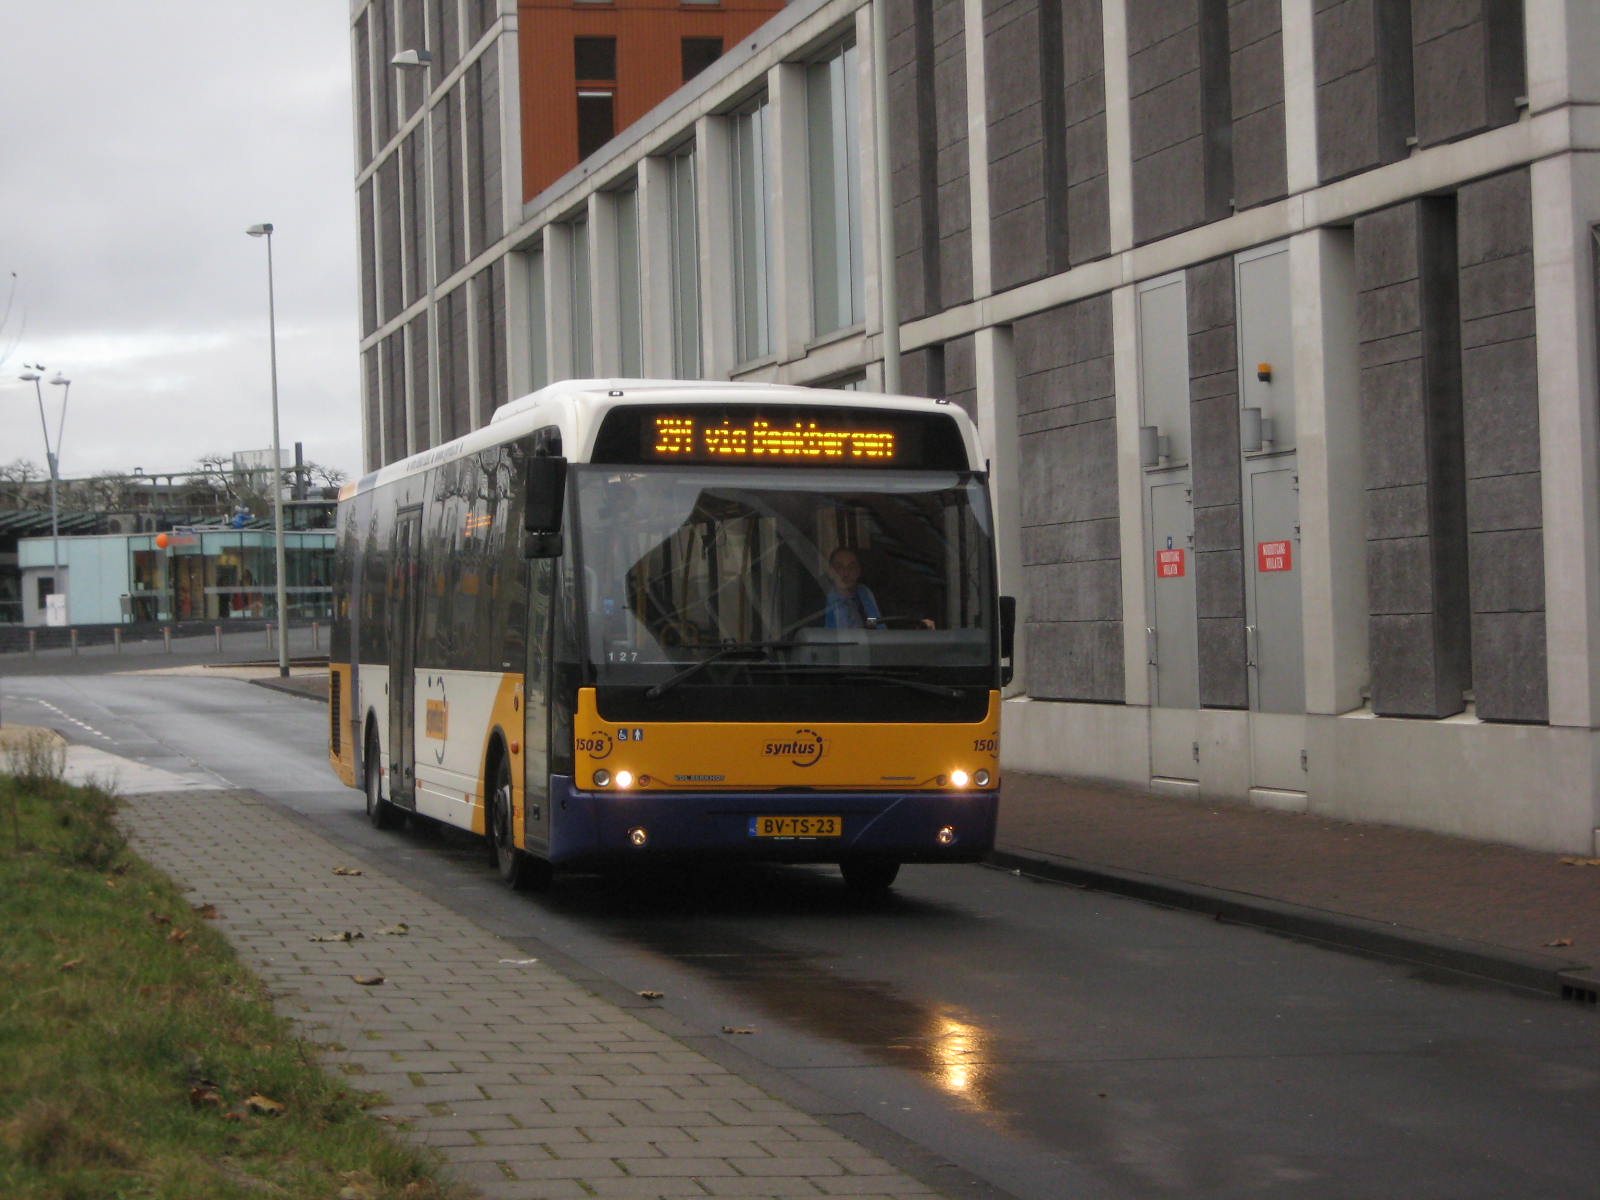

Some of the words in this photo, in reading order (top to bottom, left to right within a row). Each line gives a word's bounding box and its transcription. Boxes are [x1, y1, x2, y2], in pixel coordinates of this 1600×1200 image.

[705, 419, 747, 454] via
[575, 737, 604, 752] 1508
[764, 740, 815, 756] syntus
[764, 819, 834, 834] BV-TS-23
